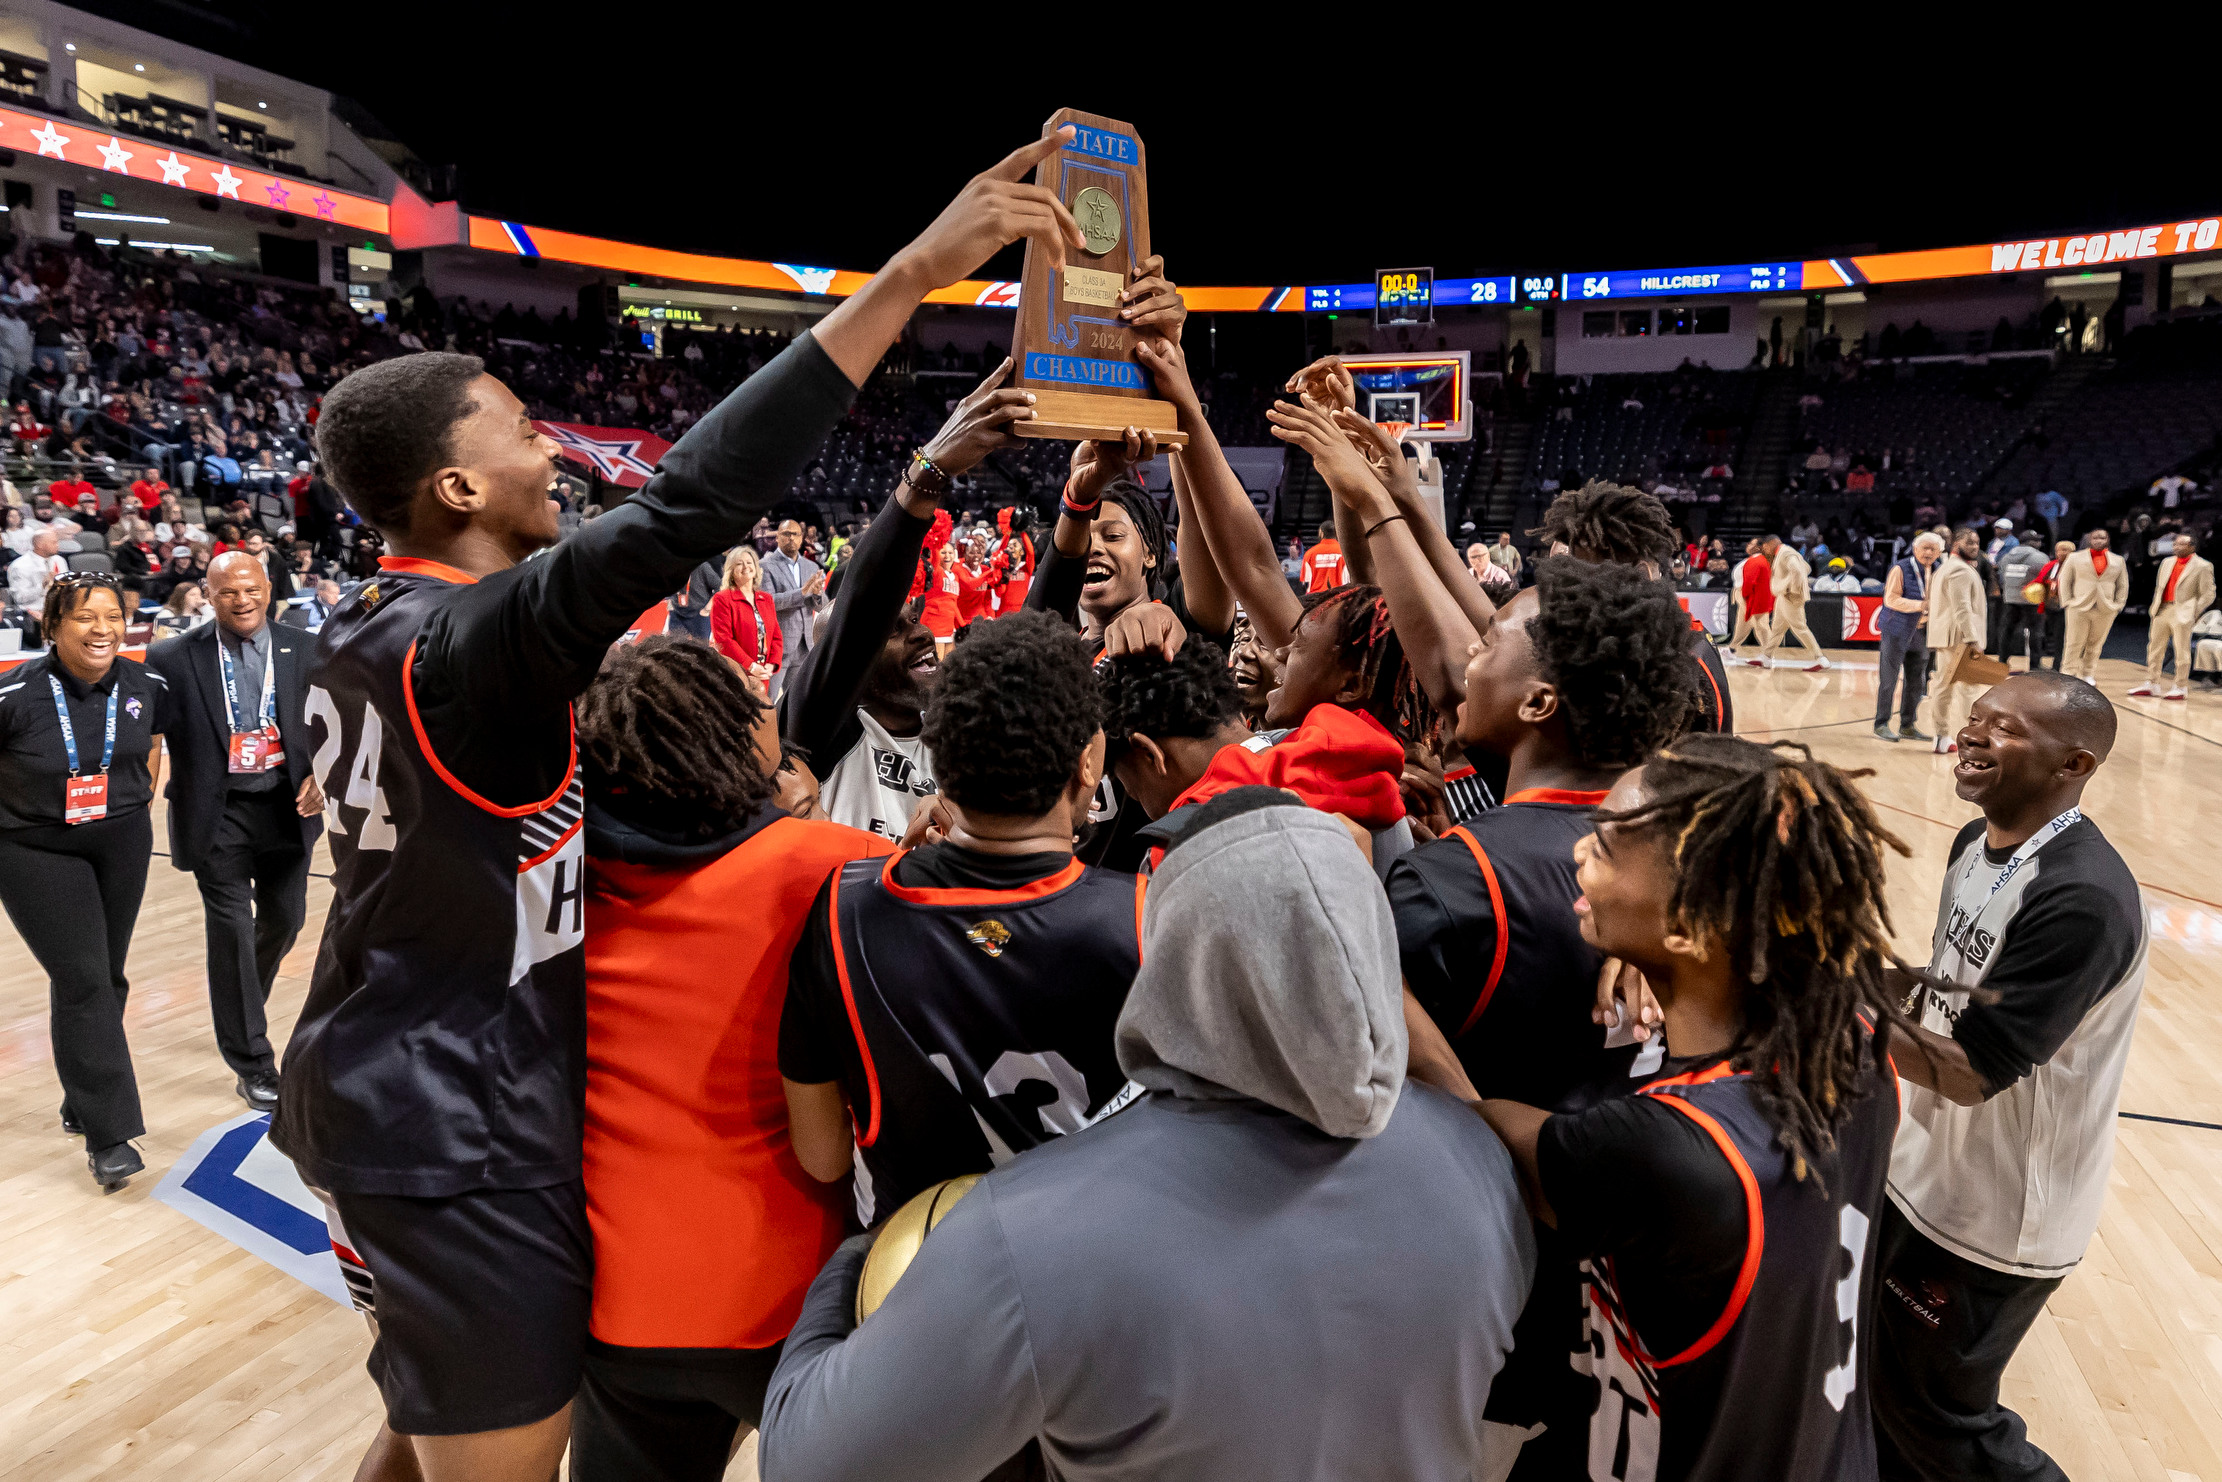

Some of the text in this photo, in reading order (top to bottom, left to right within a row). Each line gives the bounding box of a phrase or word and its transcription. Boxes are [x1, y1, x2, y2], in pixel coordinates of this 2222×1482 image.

[1991, 219, 2220, 272] WELCOME TO
[1082, 275, 1098, 286] CLASS
[1381, 273, 1418, 292] 00.0
[1523, 277, 1554, 293] 00.0
[1582, 273, 1721, 297] 54 HILLCREST
[1069, 286, 1117, 301] BOYS BASKETBALL
[1471, 282, 1498, 302] 28
[665, 308, 702, 322] GRILL
[1090, 331, 1124, 351] 2024
[1033, 356, 1145, 385] CHAMPION
[59, 714, 74, 742] AHSAA
[240, 745, 256, 767] 5
[304, 684, 398, 852] 24
[70, 784, 105, 797] STAFF
[2051, 806, 2081, 833] AHSA
[1991, 856, 2024, 895] AHSAA
[1885, 1278, 1940, 1325] BASKETBALL
